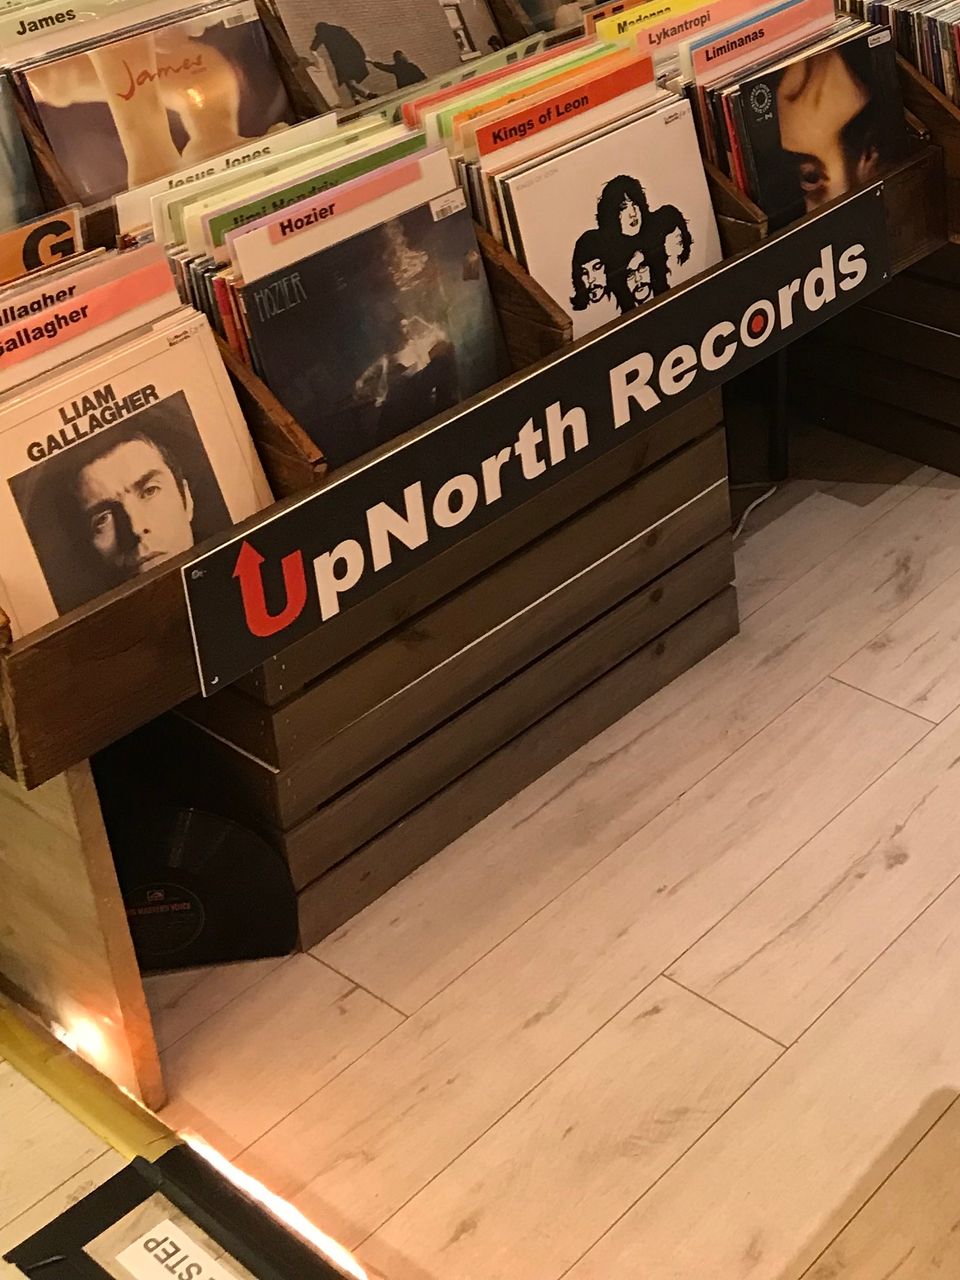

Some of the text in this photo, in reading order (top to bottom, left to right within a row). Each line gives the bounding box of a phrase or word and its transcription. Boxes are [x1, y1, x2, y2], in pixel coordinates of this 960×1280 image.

[16, 7, 77, 36] James
[648, 10, 712, 45] Lykantropi
[704, 26, 765, 63] Liminanas
[116, 54, 207, 101] James
[491, 94, 590, 145] Kings of Leon
[279, 202, 336, 237] Hozier
[22, 219, 74, 273] G
[254, 271, 308, 323] HOZIER
[26, 383, 160, 463] GALLAGHER
[58, 382, 117, 426] LIAM
[232, 242, 868, 638] UpNorth Records
